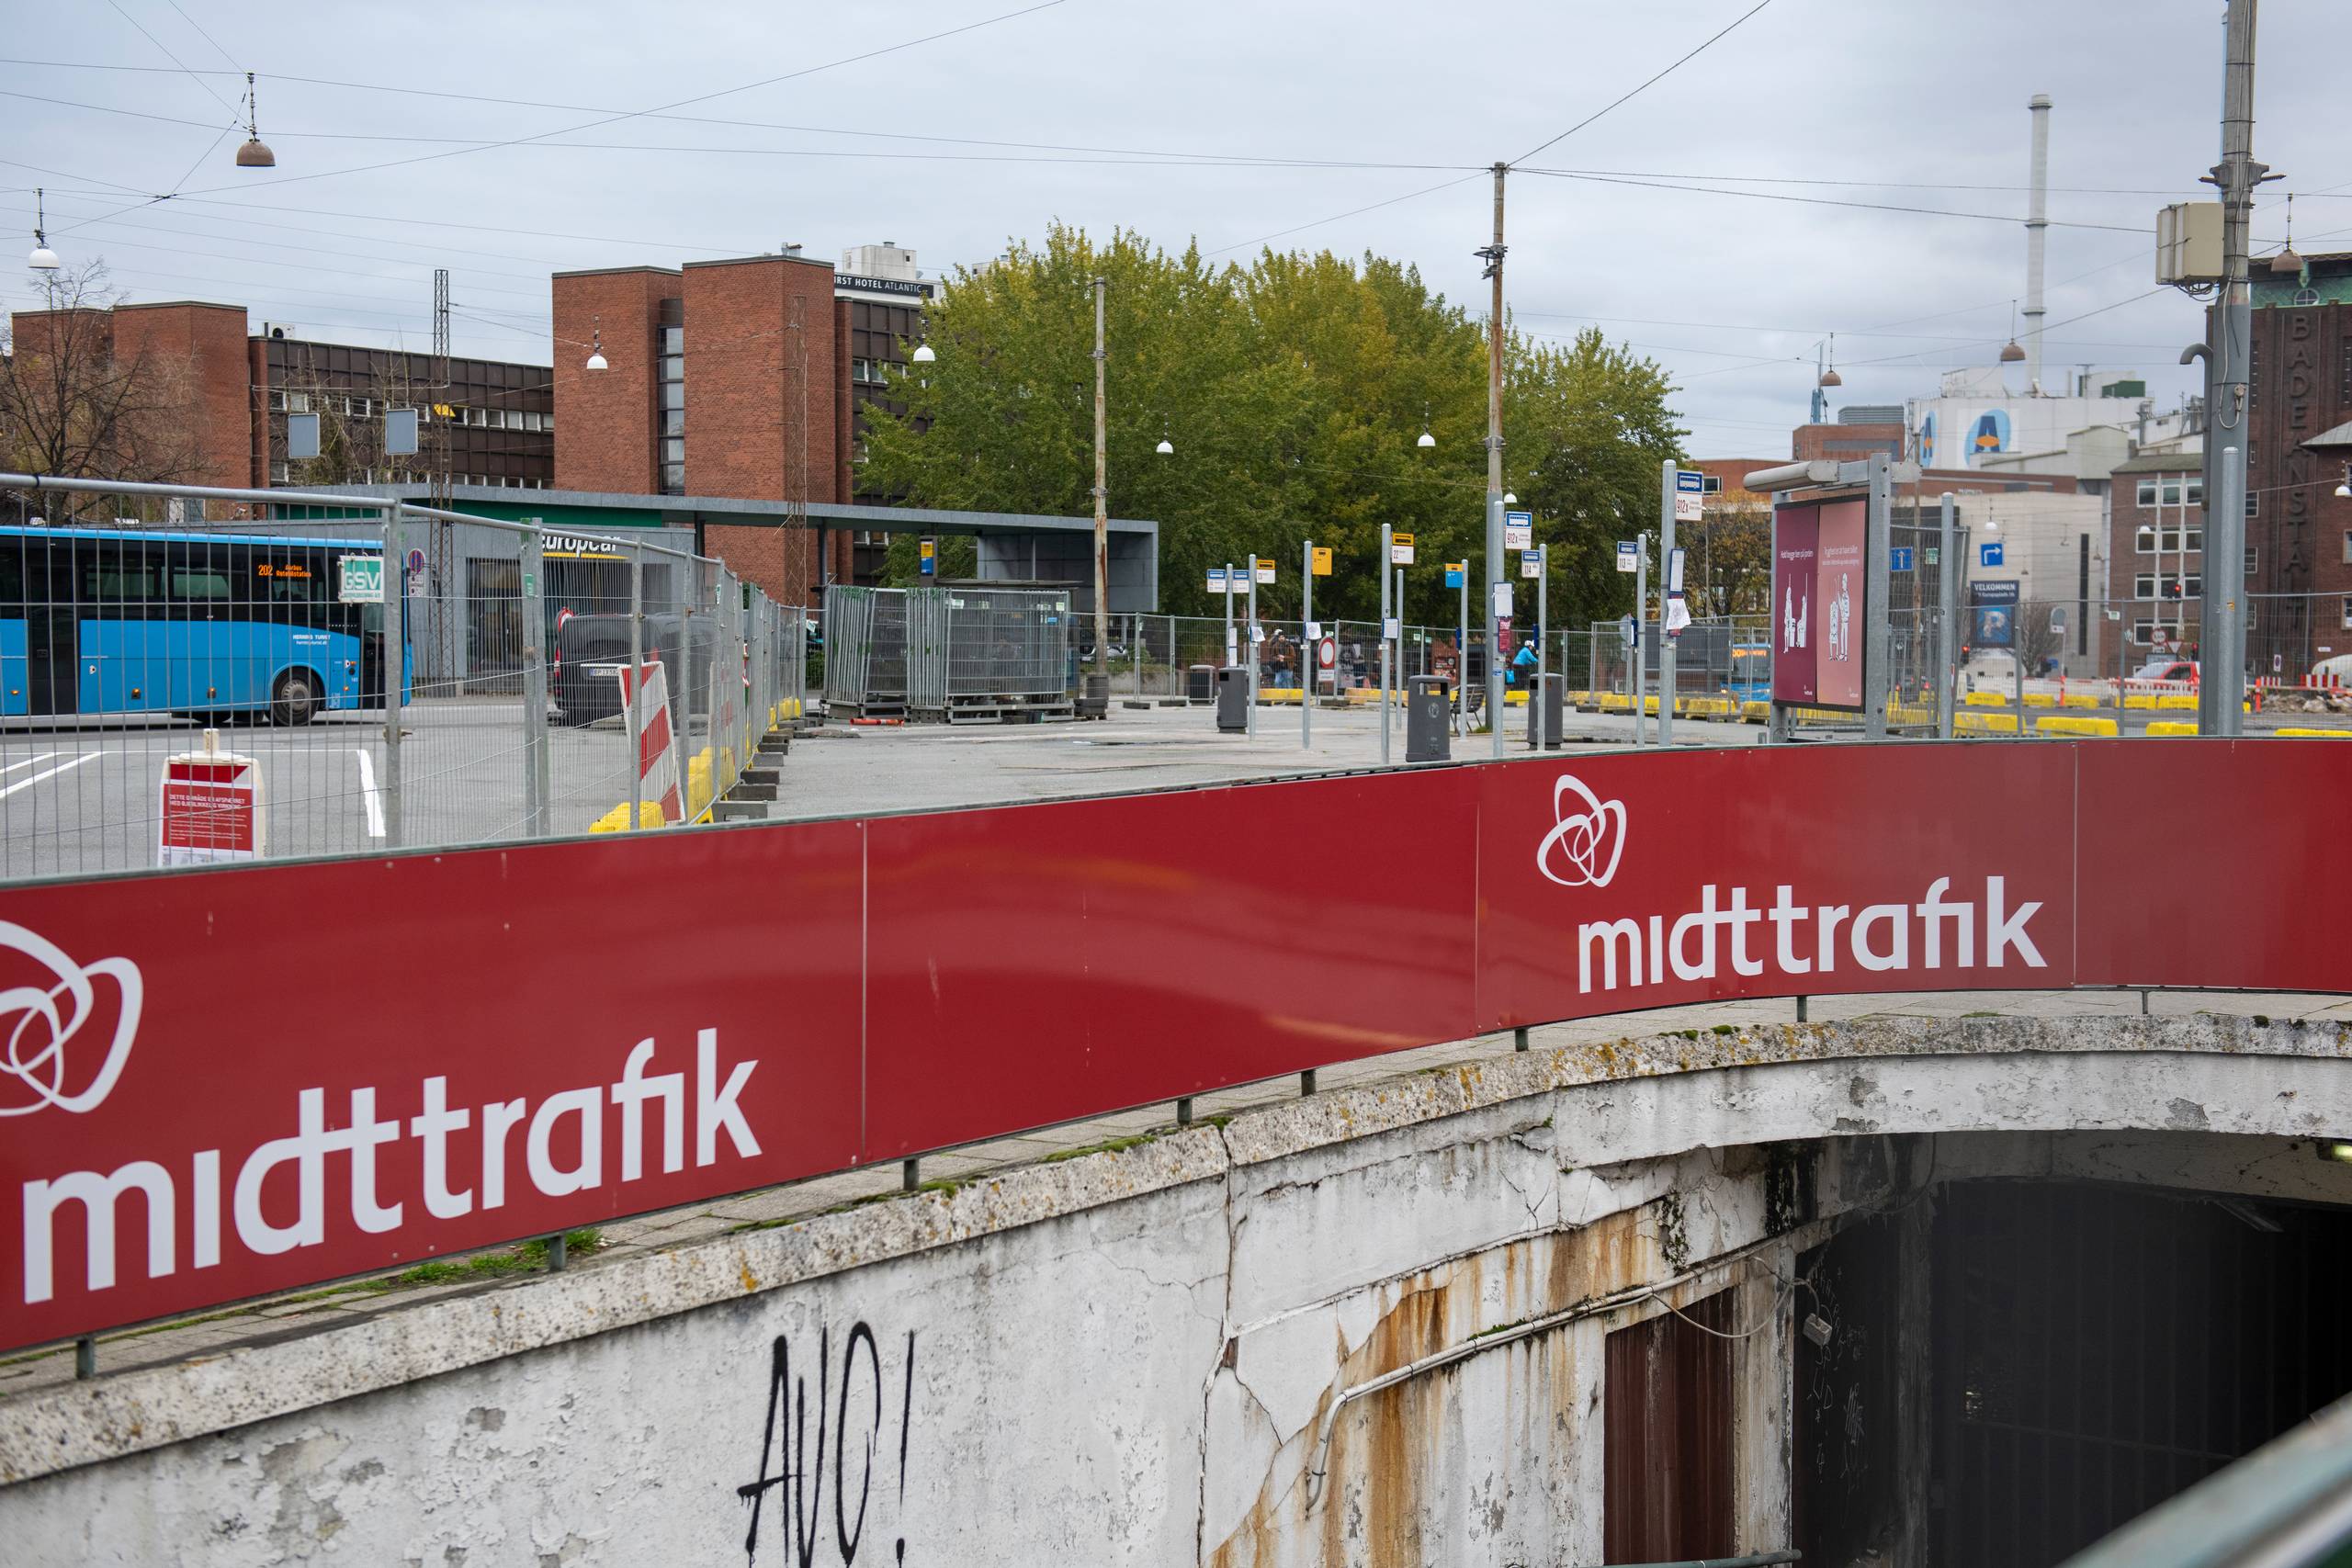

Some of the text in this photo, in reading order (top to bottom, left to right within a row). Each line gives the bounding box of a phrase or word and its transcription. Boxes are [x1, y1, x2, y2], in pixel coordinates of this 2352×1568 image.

[834, 276, 922, 293] IRST HOTEL ATLANTIC
[258, 564, 274, 576] 202
[345, 571, 380, 590] GSV
[1974, 582, 2016, 592] VELKOMMEN
[1578, 875, 2048, 994] midttrafik
[23, 1027, 763, 1304] midttrafik
